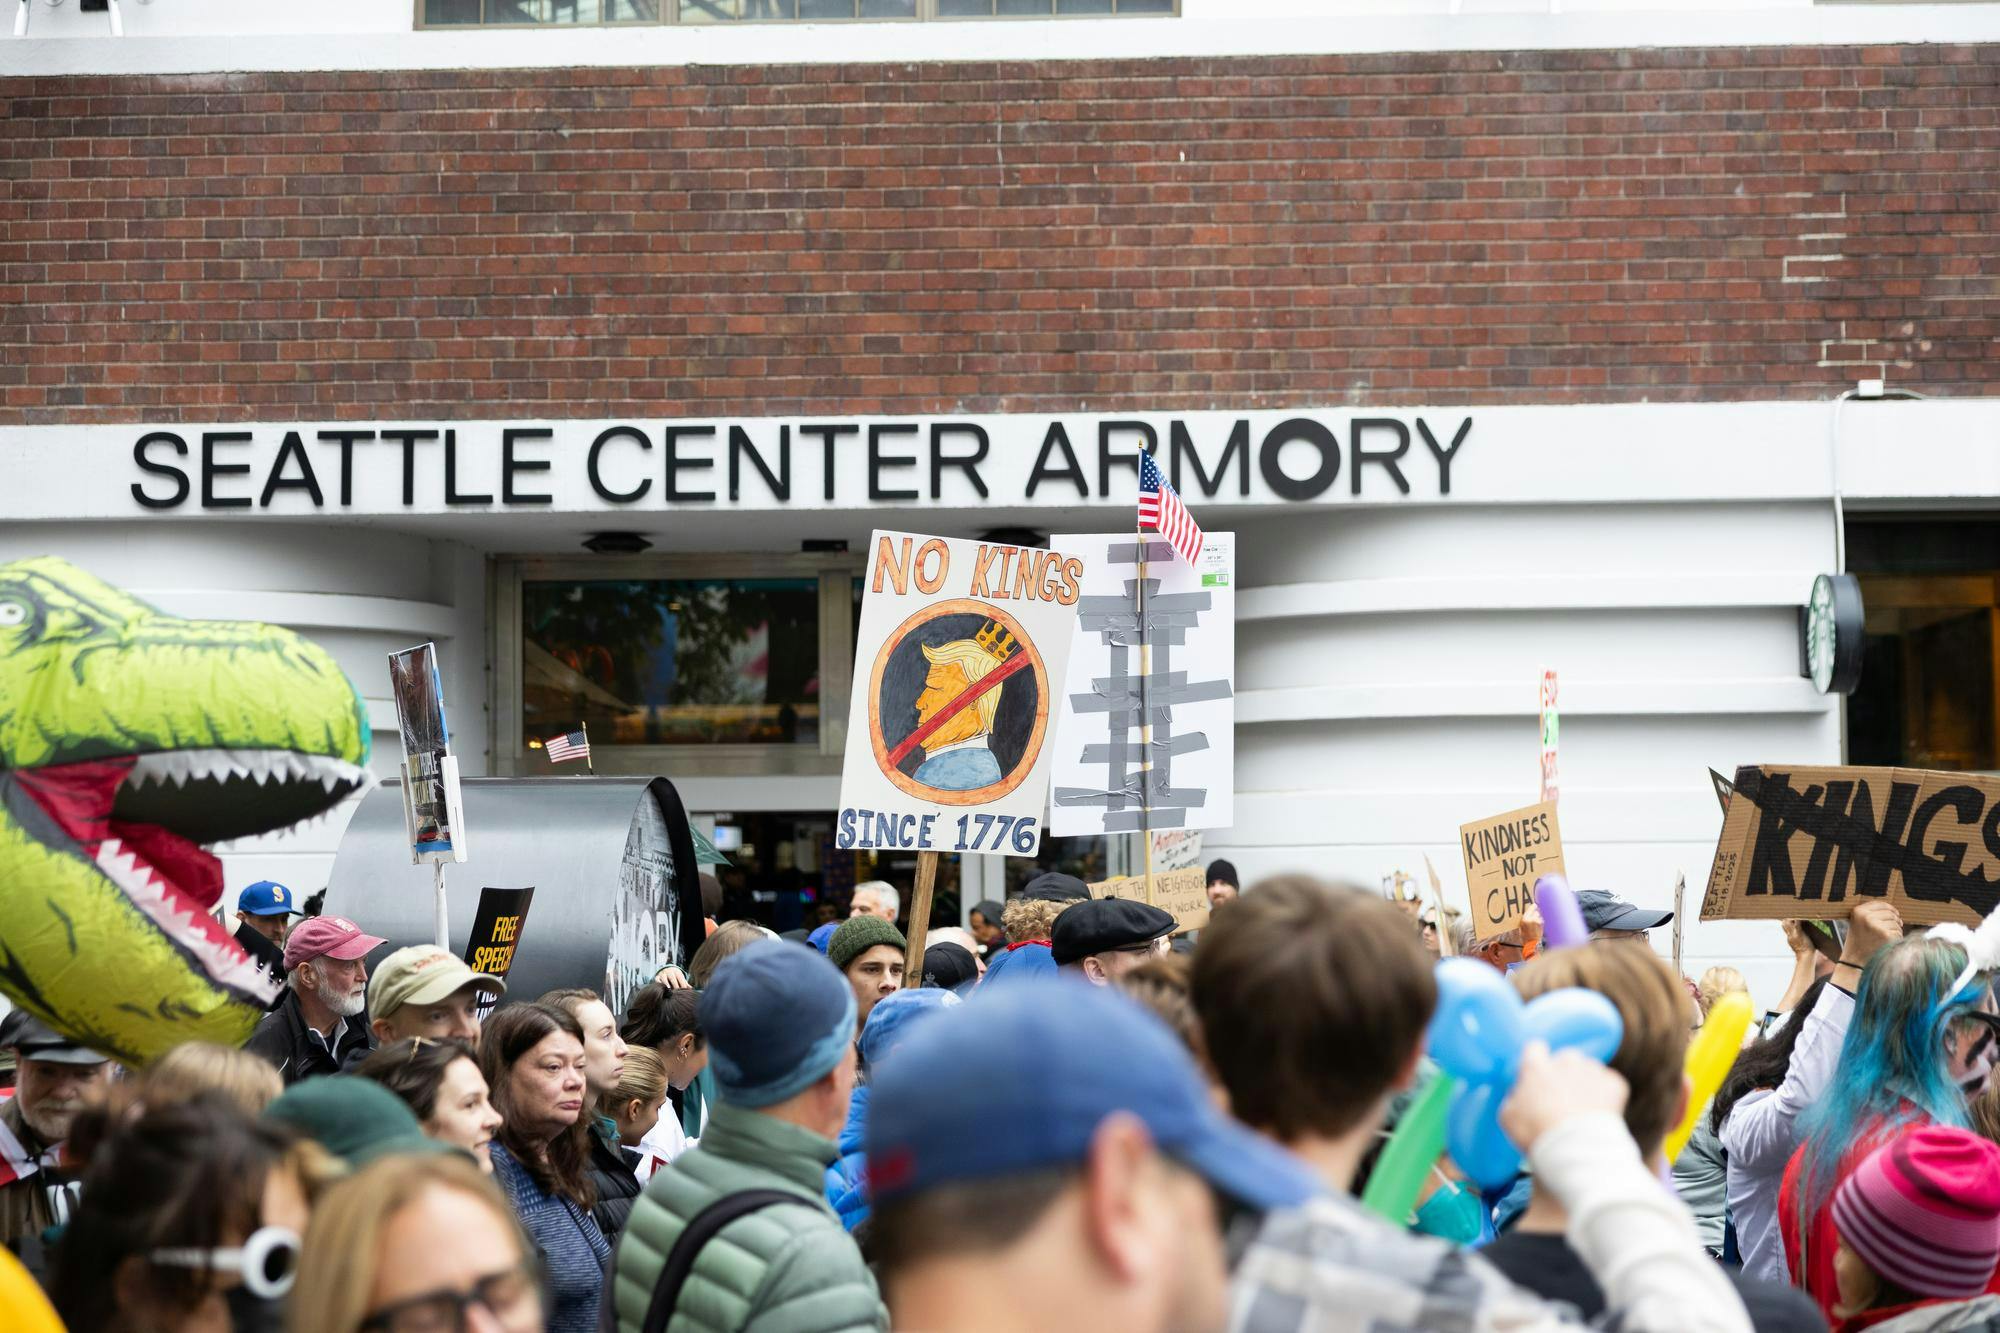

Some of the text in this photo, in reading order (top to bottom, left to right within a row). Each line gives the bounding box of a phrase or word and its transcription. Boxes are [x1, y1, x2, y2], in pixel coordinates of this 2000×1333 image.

[130, 416, 1473, 507] SEATTLE CENTER ARMORY
[872, 536, 1084, 606] NO KINGS
[954, 813, 1037, 853] 1776
[1464, 813, 1551, 869] KINDNESS
[1502, 853, 1537, 880] NOT
[1702, 851, 1729, 917] SEATTLE
[1175, 899, 1208, 913] WORK
[491, 915, 520, 943] FREE
[471, 945, 515, 973] SPEECH
